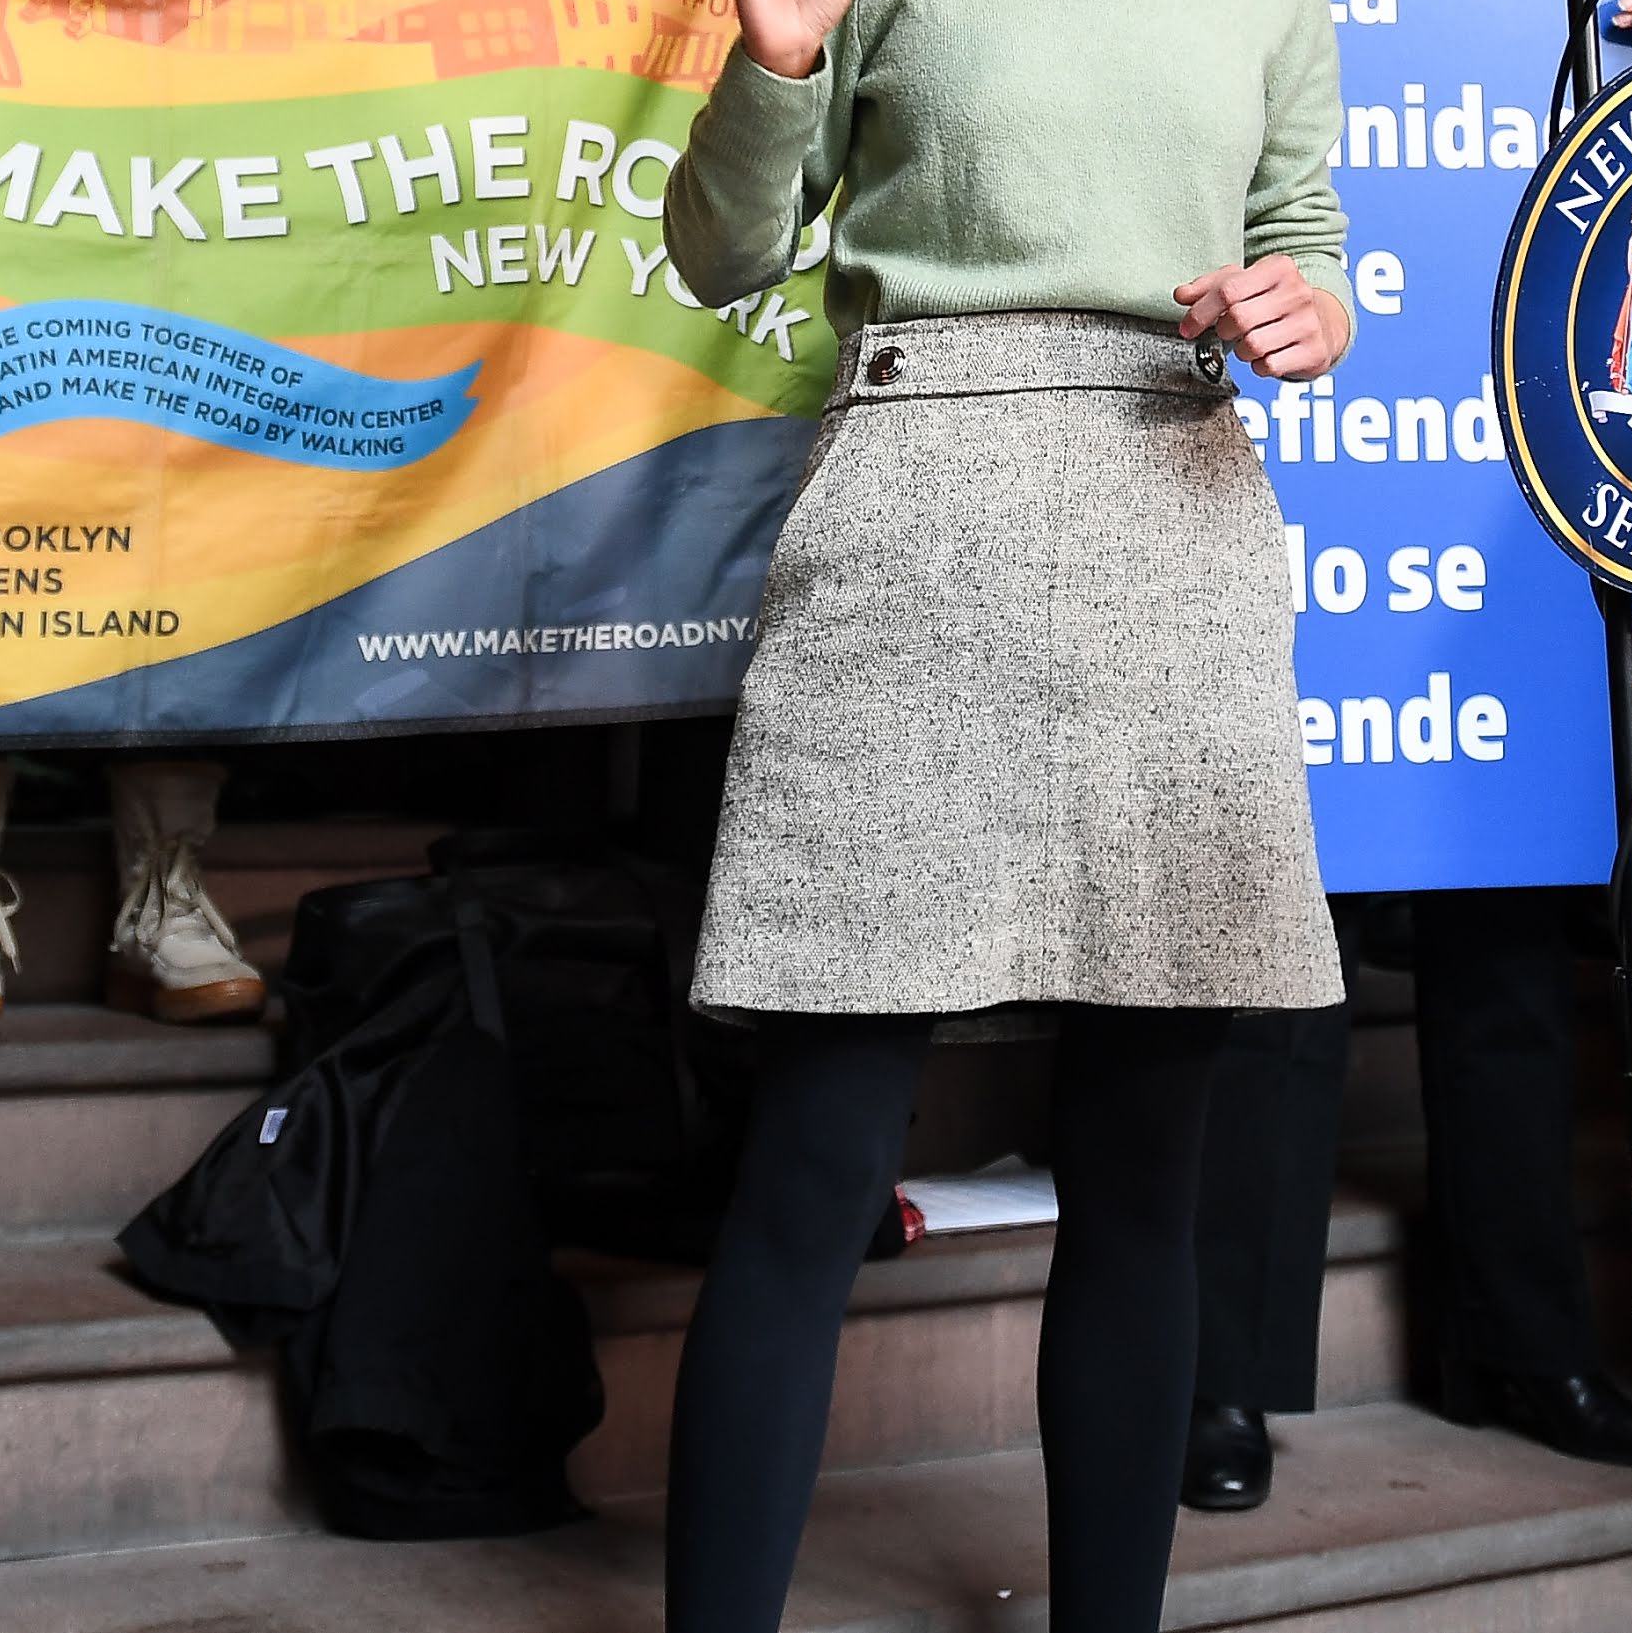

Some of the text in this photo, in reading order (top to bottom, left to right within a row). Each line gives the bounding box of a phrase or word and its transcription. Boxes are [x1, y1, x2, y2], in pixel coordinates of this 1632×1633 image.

[304, 115, 532, 226] THE
[429, 224, 596, 295] NEW
[25, 318, 131, 341] COMING
[140, 322, 265, 379] TOGETHER
[270, 366, 304, 389] OF
[66, 347, 201, 385] AMERICAN
[205, 371, 355, 429] INTEGRATION
[360, 398, 445, 430] CENTER
[61, 376, 137, 402] MAKE
[142, 384, 190, 415] THE
[193, 401, 260, 436] ROAD
[264, 422, 297, 446] BY
[301, 431, 405, 457] WALKING
[1386, 543, 1488, 614] se
[38, 609, 181, 639] ISLAND
[357, 616, 758, 664] WWW.MAKETHEROADNY.
